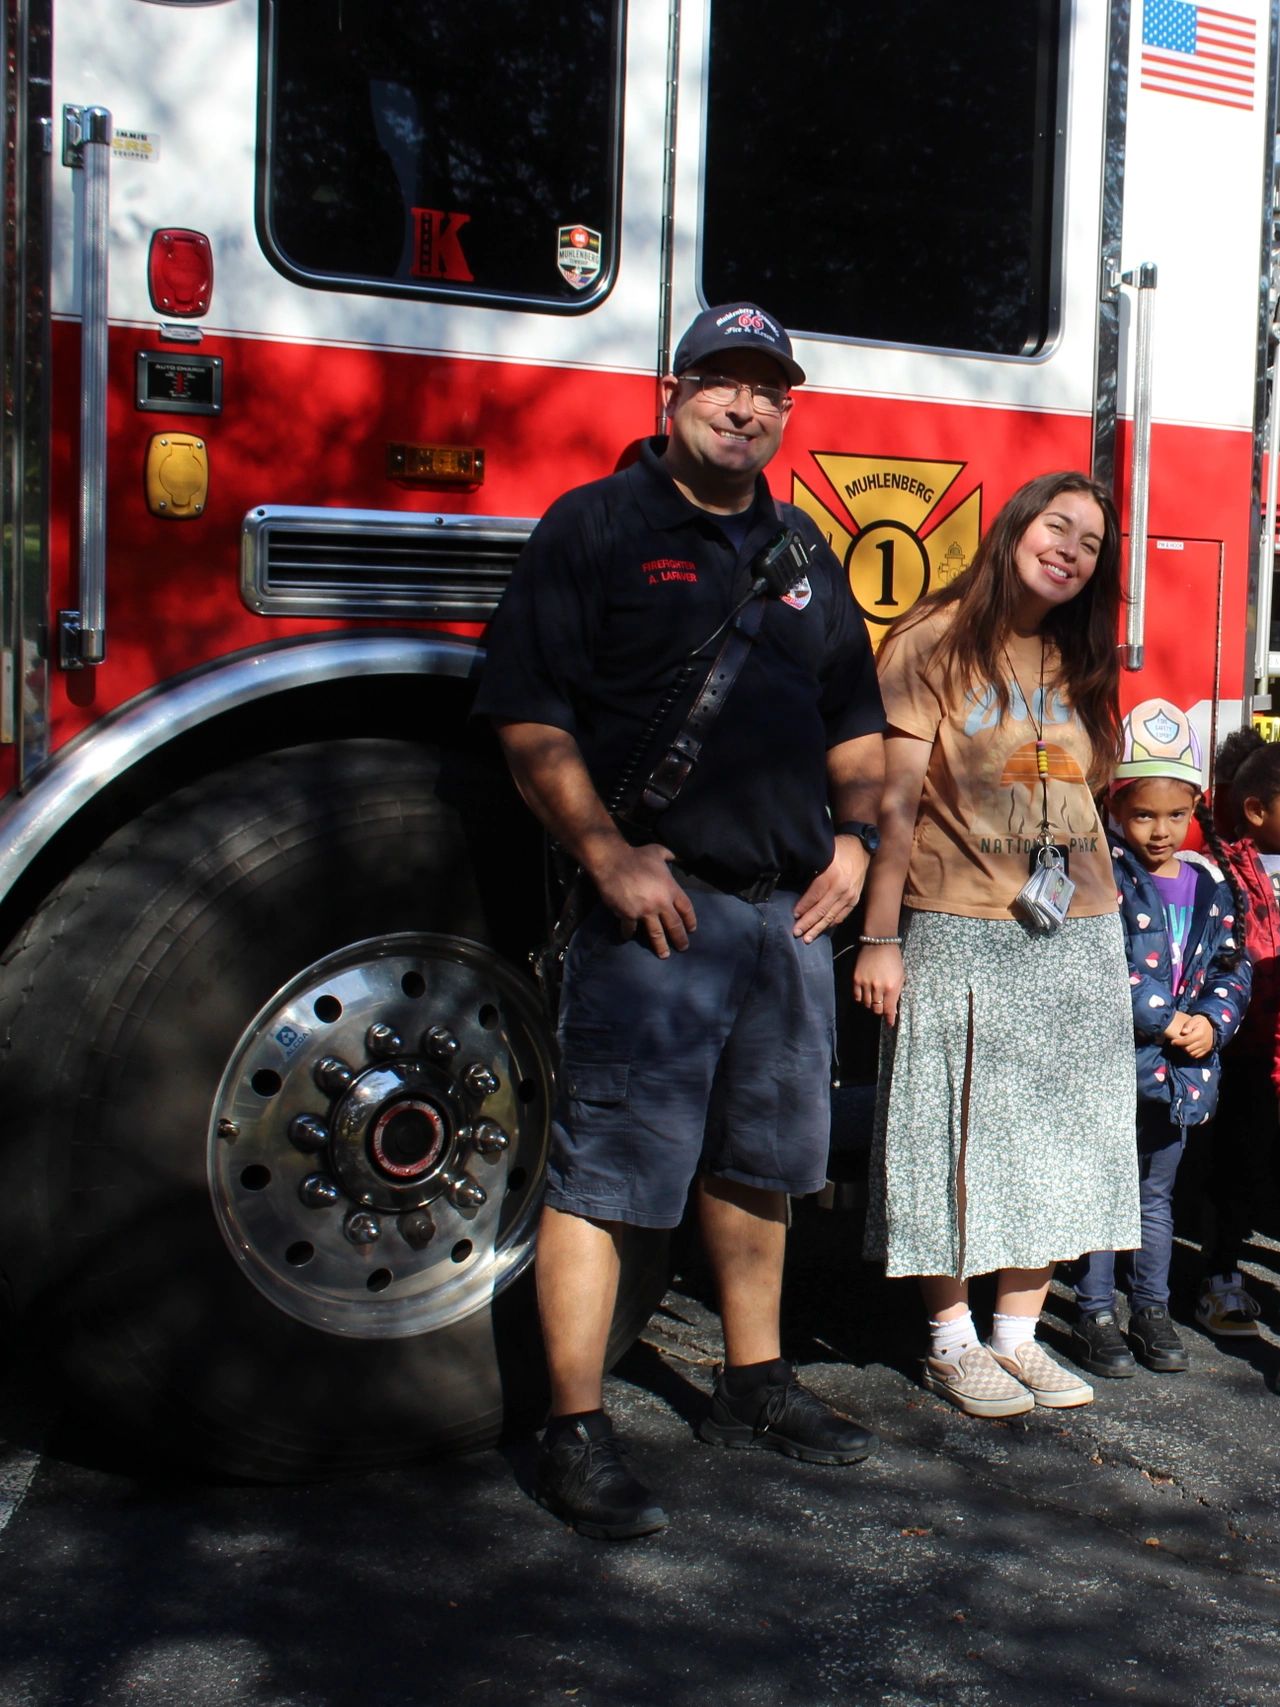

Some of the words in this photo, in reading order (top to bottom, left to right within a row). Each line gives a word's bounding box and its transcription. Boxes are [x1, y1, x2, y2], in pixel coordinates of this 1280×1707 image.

[738, 313, 764, 330] 66
[844, 472, 935, 504] MUHLENBERG
[641, 559, 697, 573] FIREFIGHTER
[873, 538, 900, 607] 1
